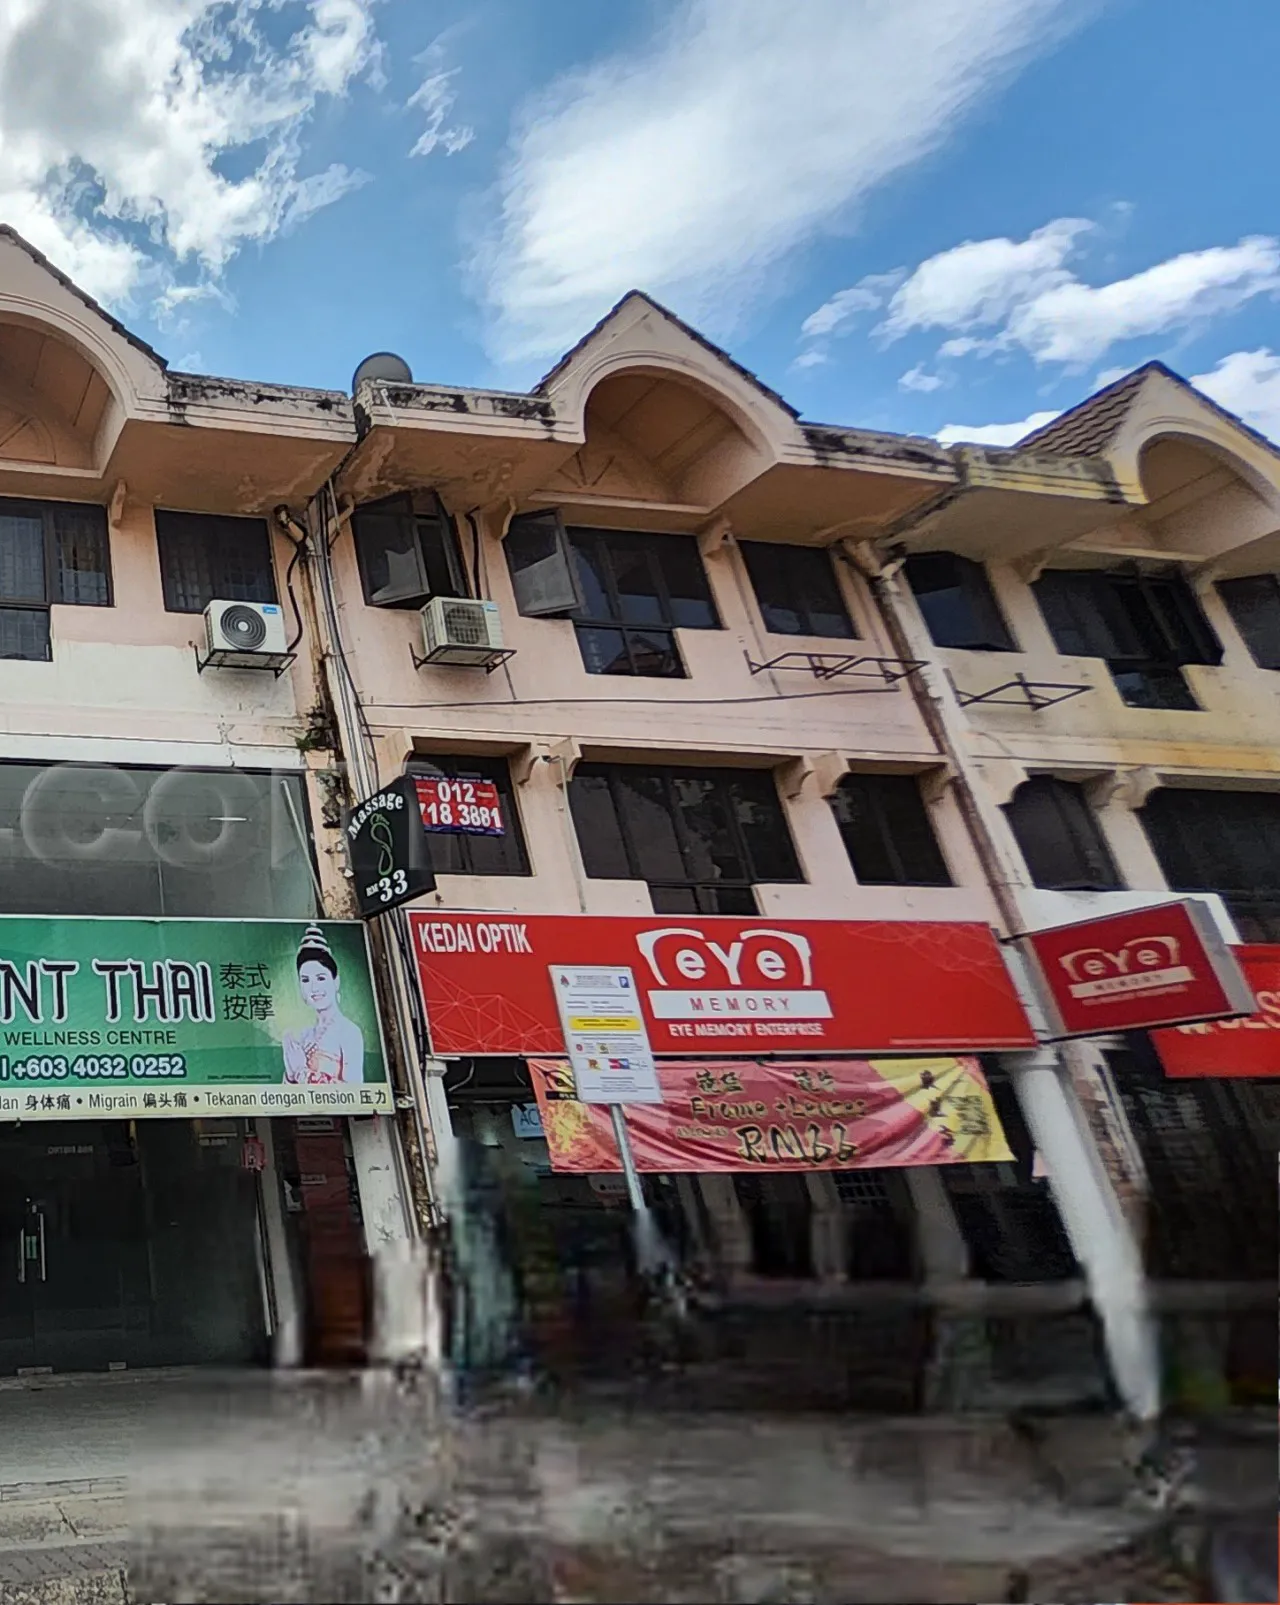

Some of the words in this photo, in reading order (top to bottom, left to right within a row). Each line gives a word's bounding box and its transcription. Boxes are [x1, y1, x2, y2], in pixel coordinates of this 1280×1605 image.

[437, 781, 477, 804] 012
[347, 792, 404, 841] Massage
[457, 804, 502, 829] 3881
[379, 869, 409, 902] 33
[418, 923, 476, 953] KEDAI
[476, 923, 534, 953] OPTIK
[220, 962, 271, 990] 泰式
[92, 957, 216, 1025] THAI
[222, 992, 275, 1021] 按摩
[688, 996, 790, 1012] MEMORY
[3, 1030, 101, 1046] WELLNESS
[106, 1029, 177, 1046] CENTRE
[668, 1023, 695, 1037] EYE
[695, 1022, 754, 1036] MEMORY
[754, 1022, 825, 1036] ENTERPRISE
[12, 1056, 67, 1078] +603
[72, 1056, 127, 1078] 4032
[130, 1055, 185, 1077] 0252
[24, 1093, 71, 1111] 身体痛
[88, 1093, 138, 1111] Migrain
[143, 1092, 188, 1109] 偏头痛
[204, 1092, 257, 1107] Tekanan
[260, 1091, 307, 1108] dengan
[307, 1090, 355, 1105] Tension
[359, 1089, 388, 1106] 压力
